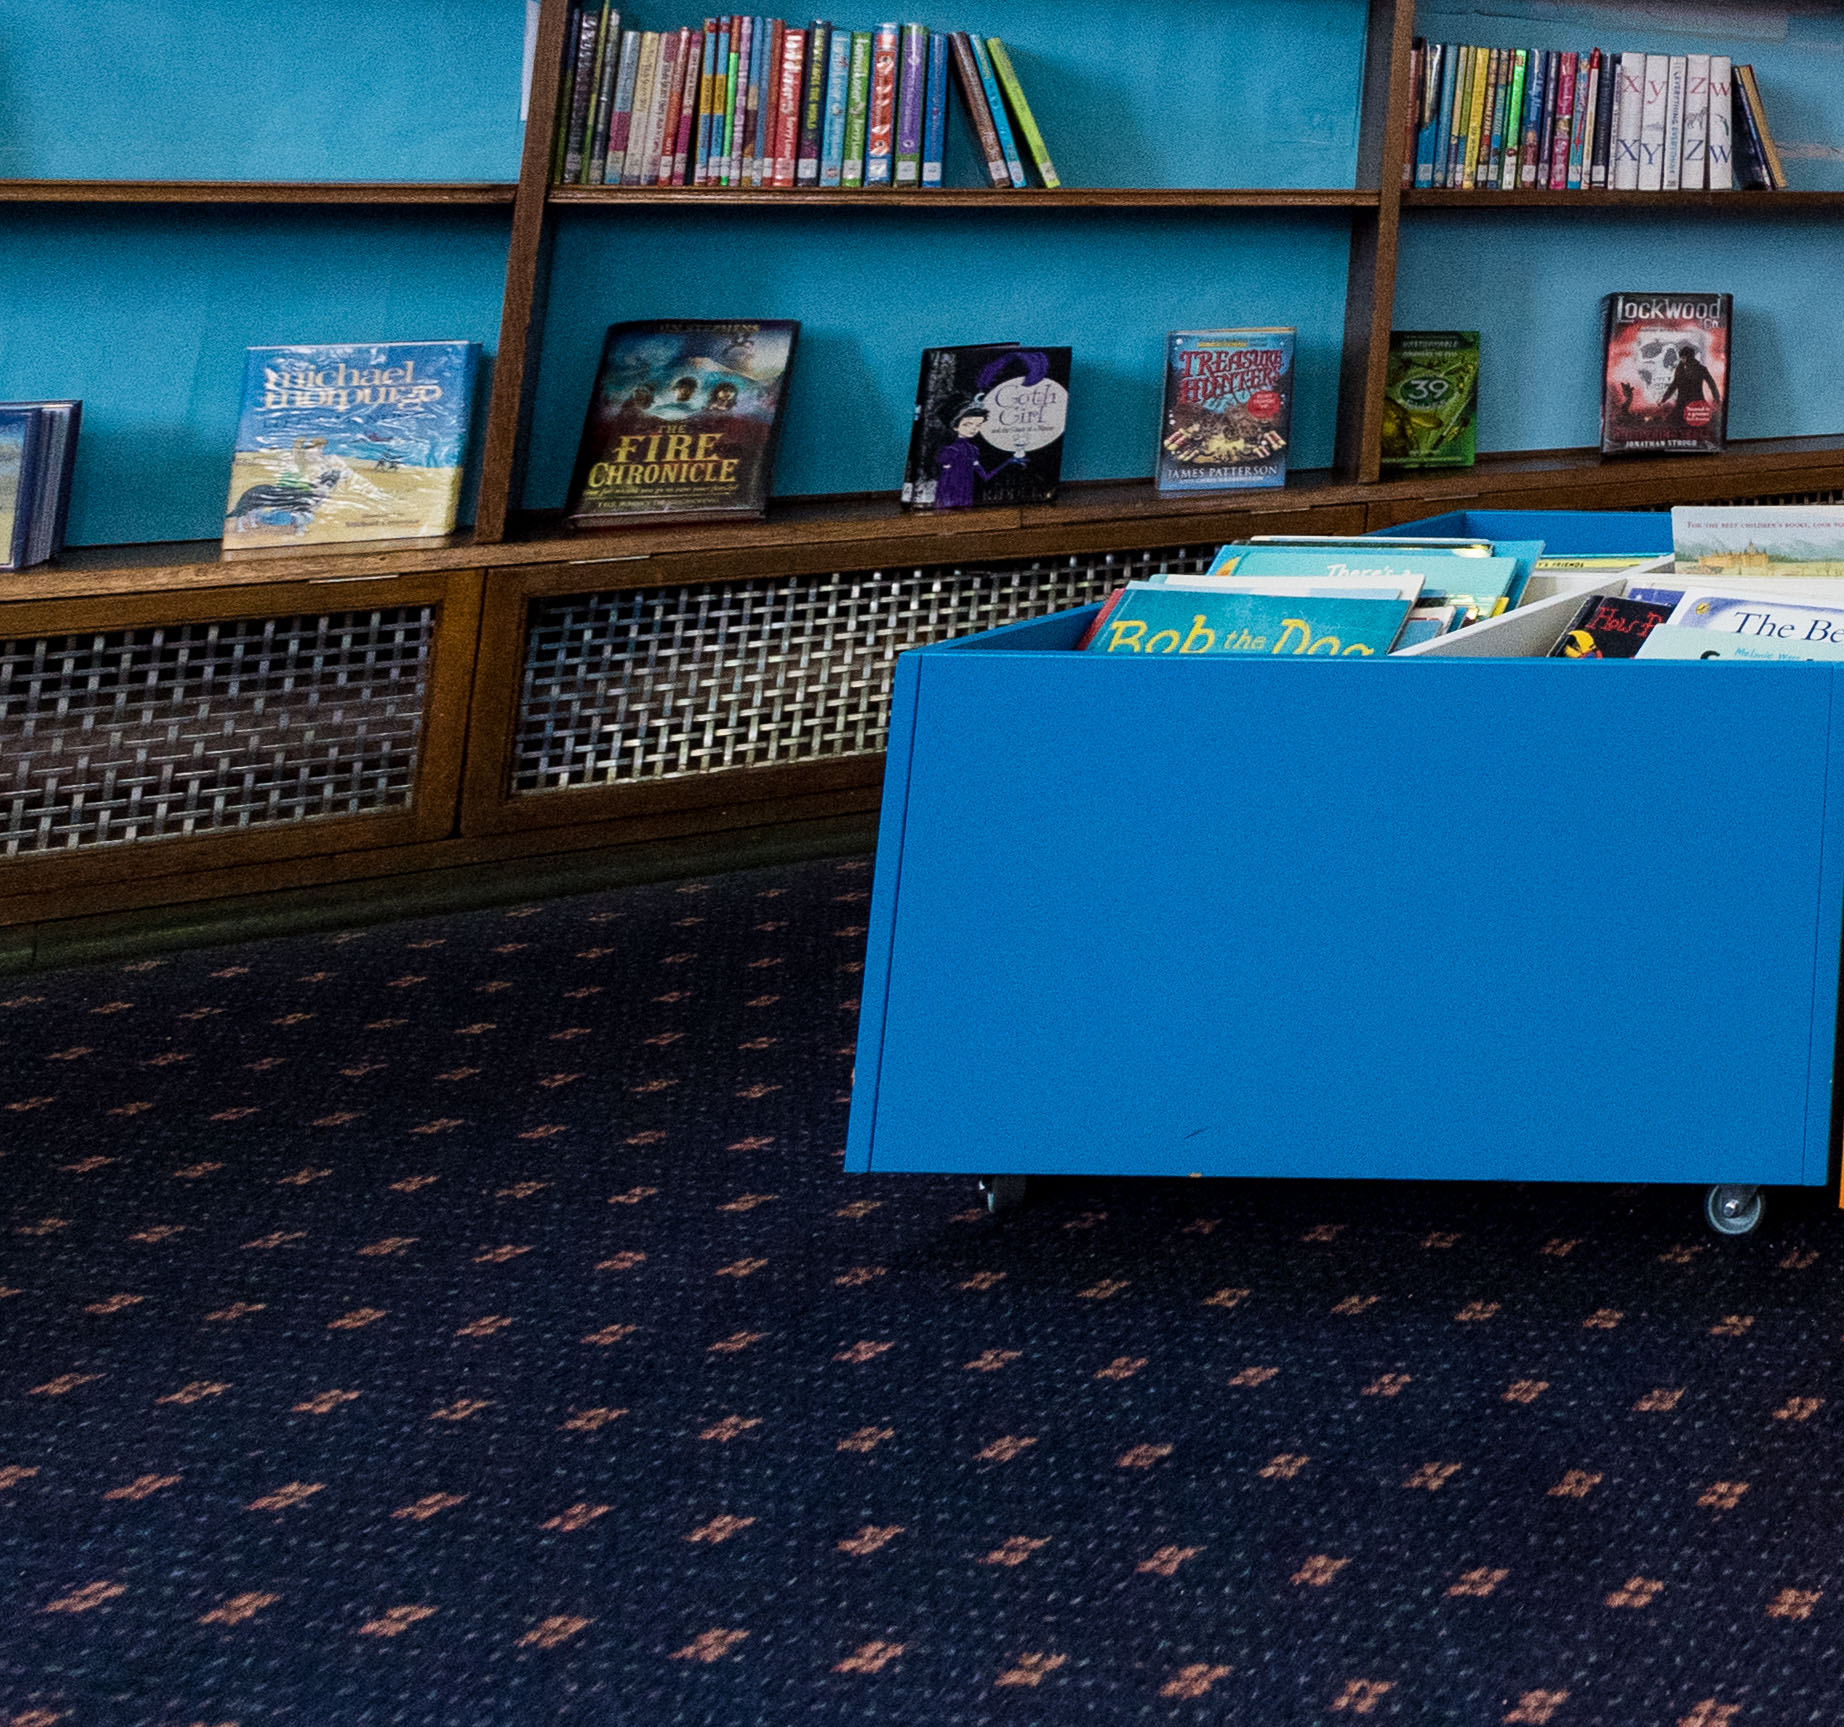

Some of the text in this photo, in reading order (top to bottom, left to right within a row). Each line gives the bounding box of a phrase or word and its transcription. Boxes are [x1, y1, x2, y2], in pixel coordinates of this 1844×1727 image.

[1617, 295, 1721, 323] Lockwood
[265, 361, 414, 390] michael
[1179, 350, 1283, 377] TREASURE
[995, 384, 1056, 408] Goth
[1408, 379, 1449, 400] 39
[999, 406, 1045, 425] Girl
[612, 433, 724, 463] FIRE
[588, 459, 740, 487] CHRONICLE
[1168, 469, 1204, 480] JAMES
[1209, 465, 1278, 478] PATTERSON
[1327, 563, 1395, 577] There's
[1108, 615, 1214, 654] Bob
[1225, 631, 1265, 650] the
[1734, 611, 1796, 639] The
